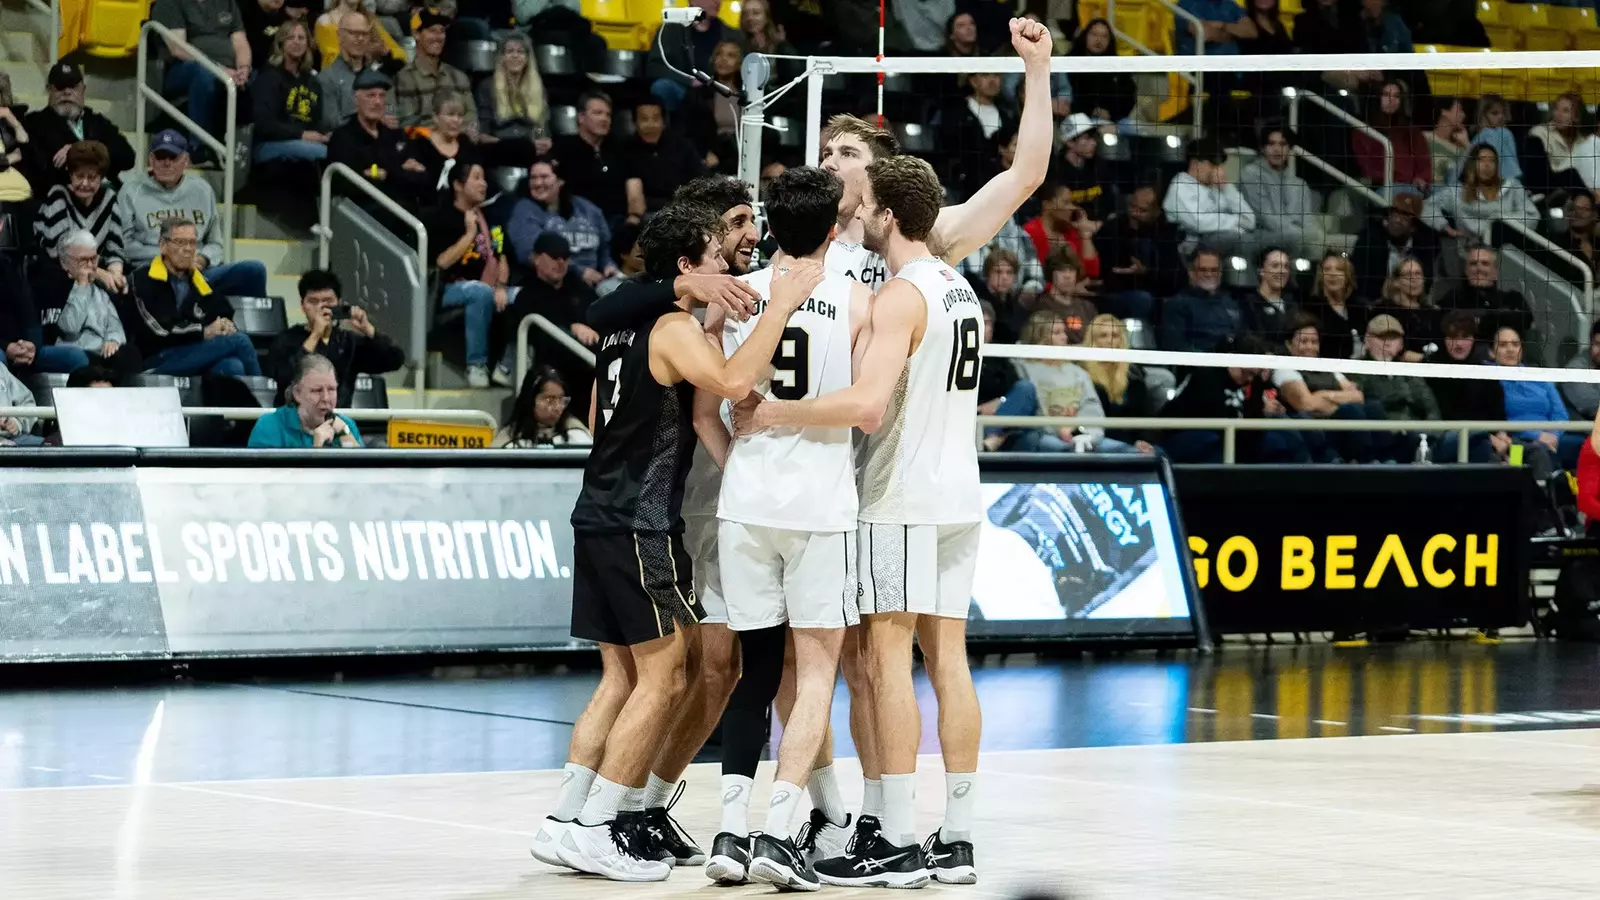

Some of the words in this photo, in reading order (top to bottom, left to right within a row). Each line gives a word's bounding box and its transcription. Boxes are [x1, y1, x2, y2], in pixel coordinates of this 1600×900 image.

[844, 266, 885, 284] ACH
[797, 298, 837, 320] ACH
[770, 326, 810, 401] 9
[946, 317, 980, 392] 18
[397, 431, 458, 447] SECTION
[461, 435, 485, 449] 103
[36, 521, 179, 585] LABEL
[181, 520, 345, 584] SPORTS
[349, 519, 571, 582] NUTRITION.
[1188, 534, 1259, 592] GO
[1281, 533, 1498, 590] BEACH
